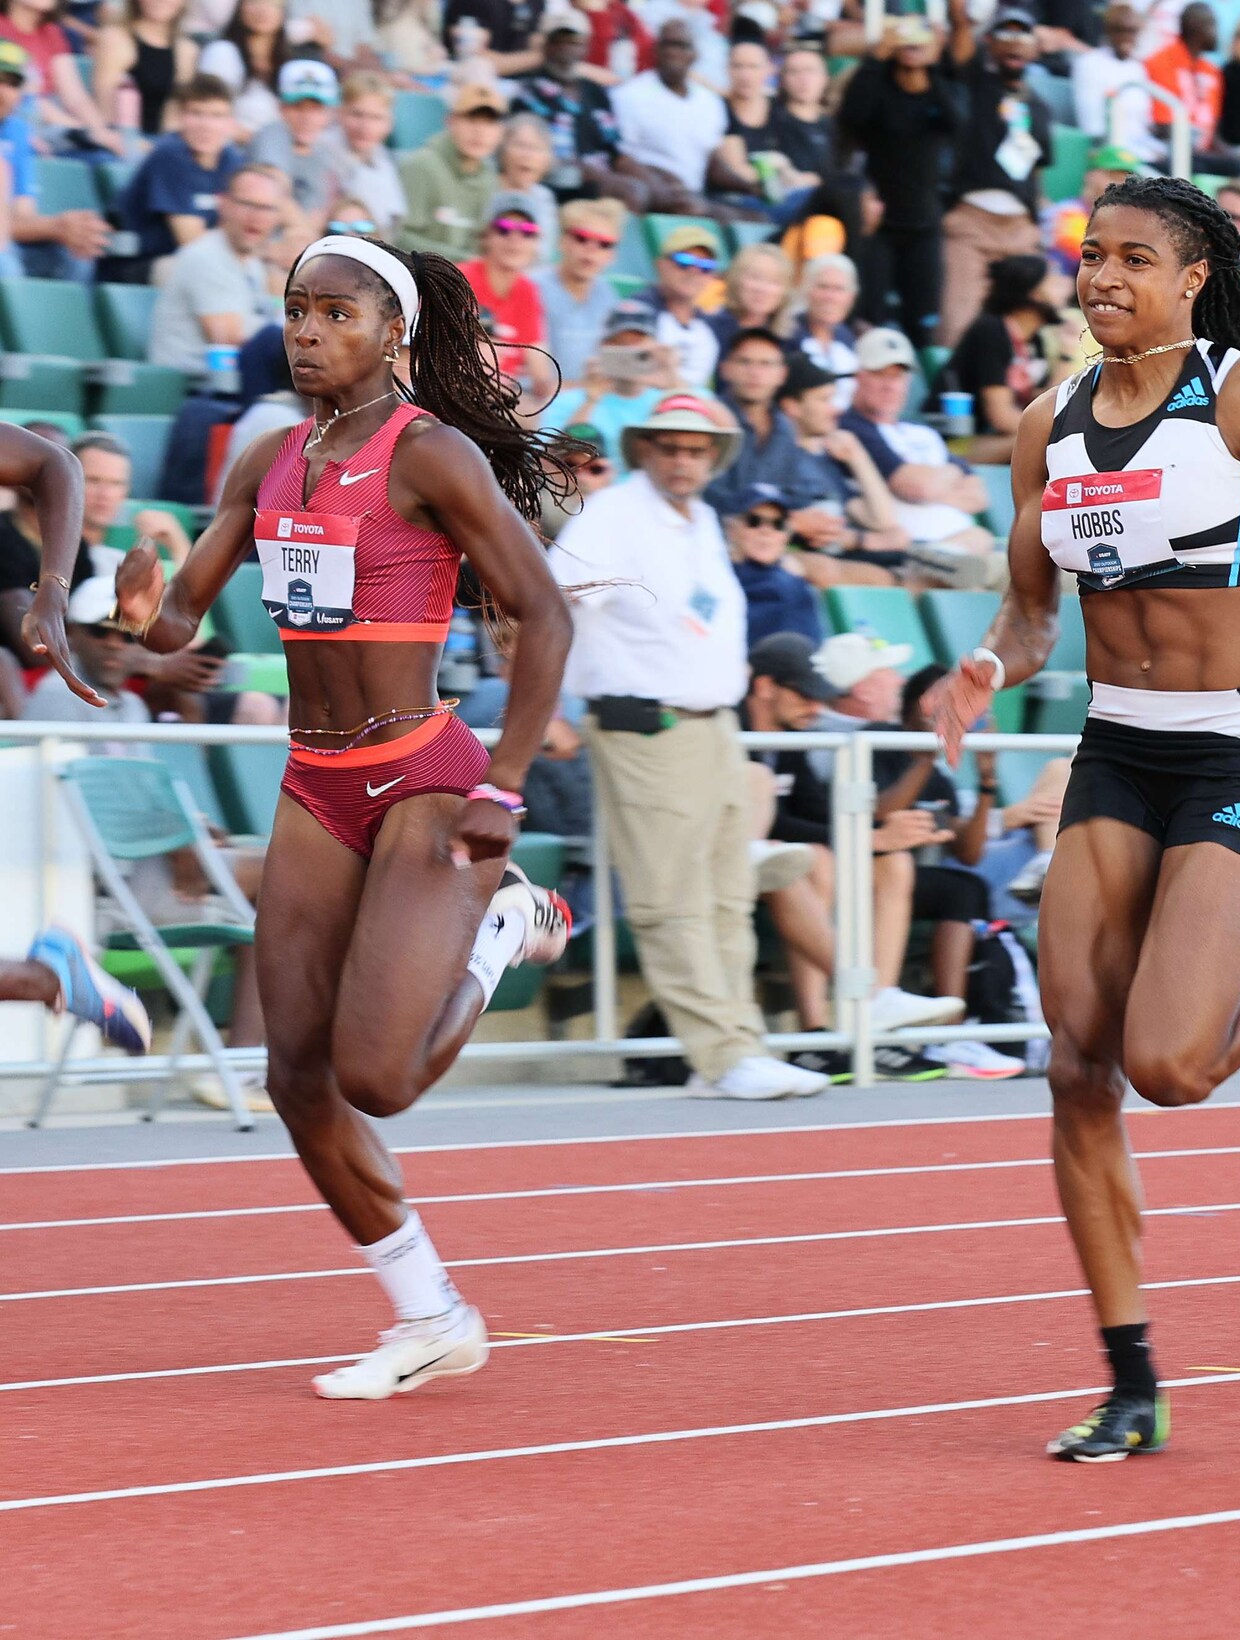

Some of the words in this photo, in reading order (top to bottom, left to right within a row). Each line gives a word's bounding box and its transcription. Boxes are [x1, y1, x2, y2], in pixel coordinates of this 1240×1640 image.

[1166, 395, 1210, 412] adidas
[1084, 484, 1124, 497] TOYOTA
[293, 523, 325, 535] TOYOTA
[1070, 509, 1124, 540] HOBBS
[281, 546, 320, 574] TERRY
